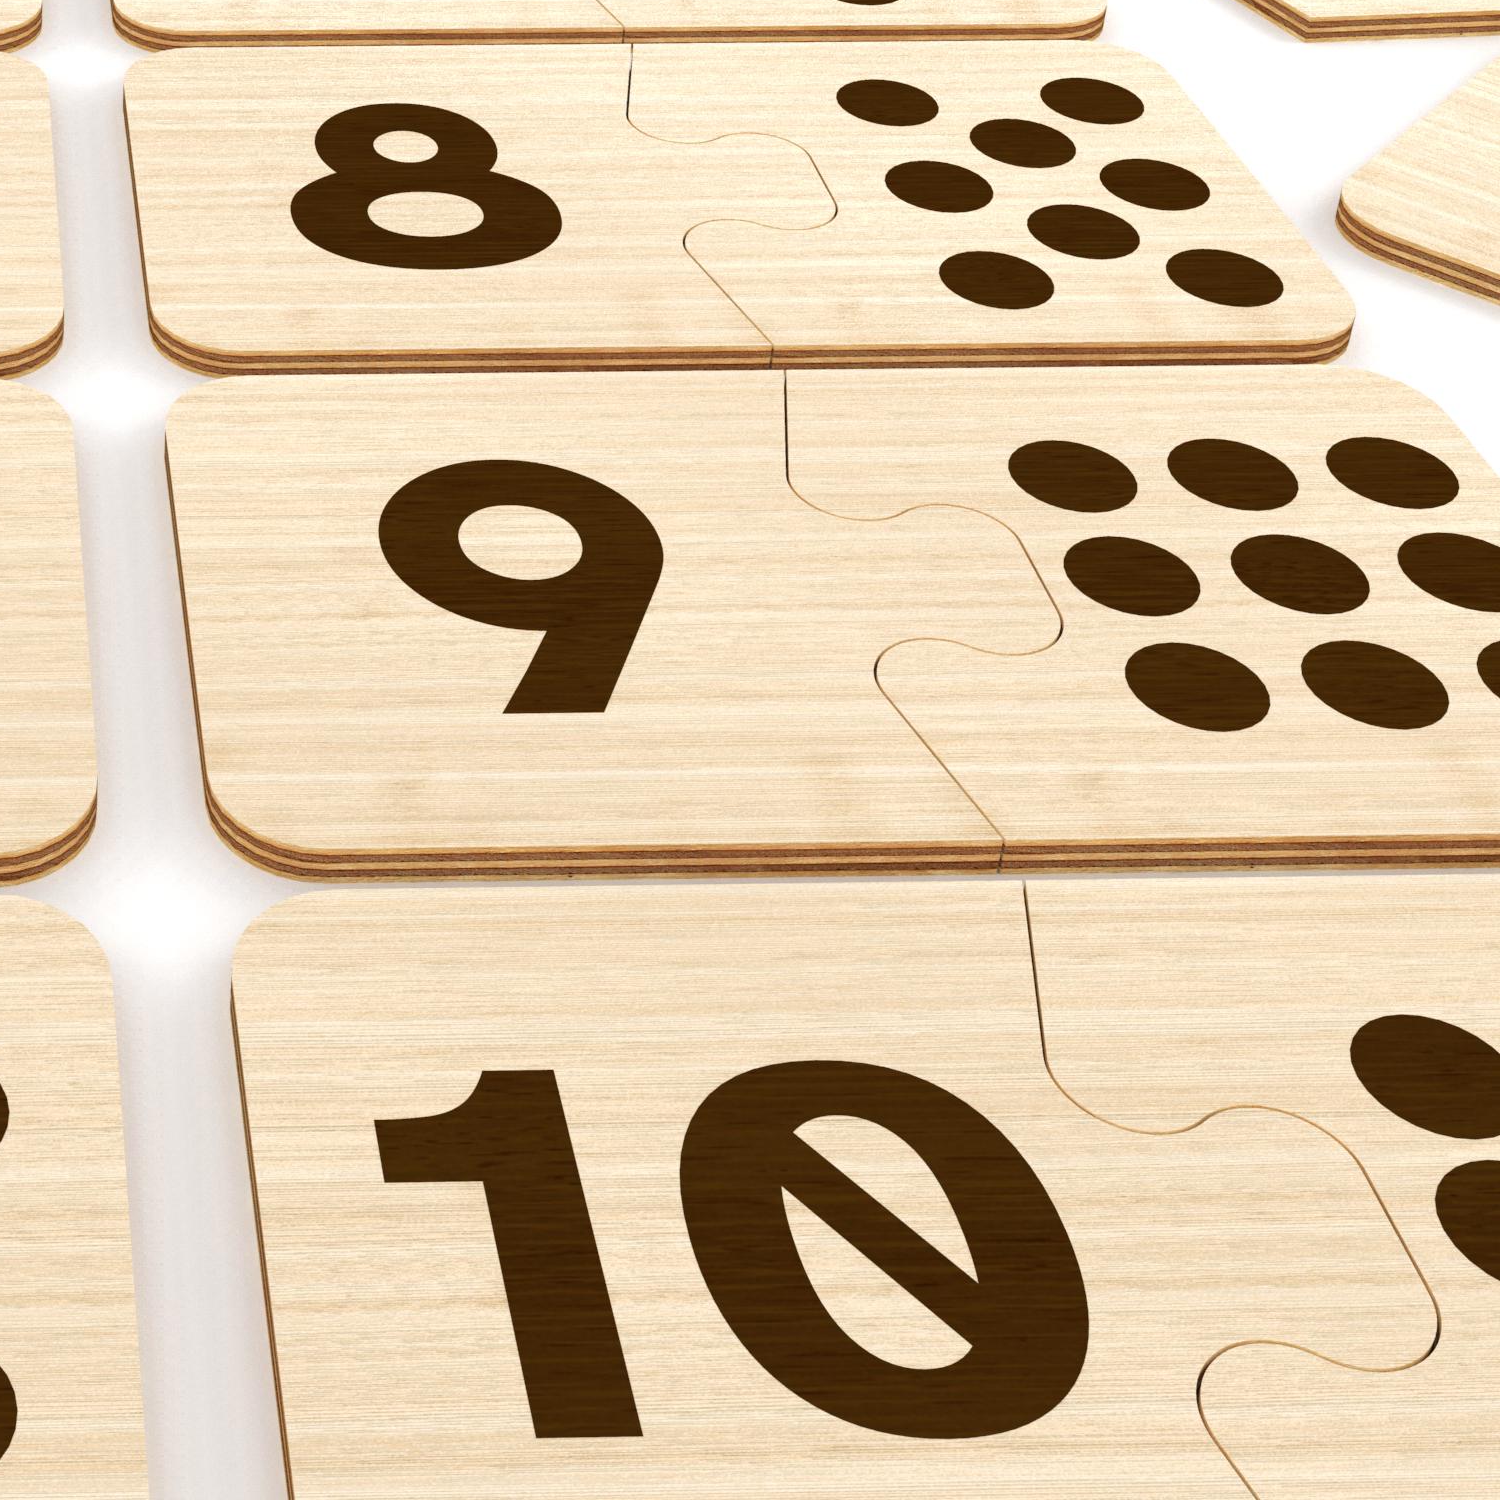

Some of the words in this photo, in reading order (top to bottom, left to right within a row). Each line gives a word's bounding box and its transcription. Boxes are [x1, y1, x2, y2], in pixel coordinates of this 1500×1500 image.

[290, 103, 562, 270] 8
[378, 459, 664, 714] 9
[374, 1060, 1090, 1440] 10
